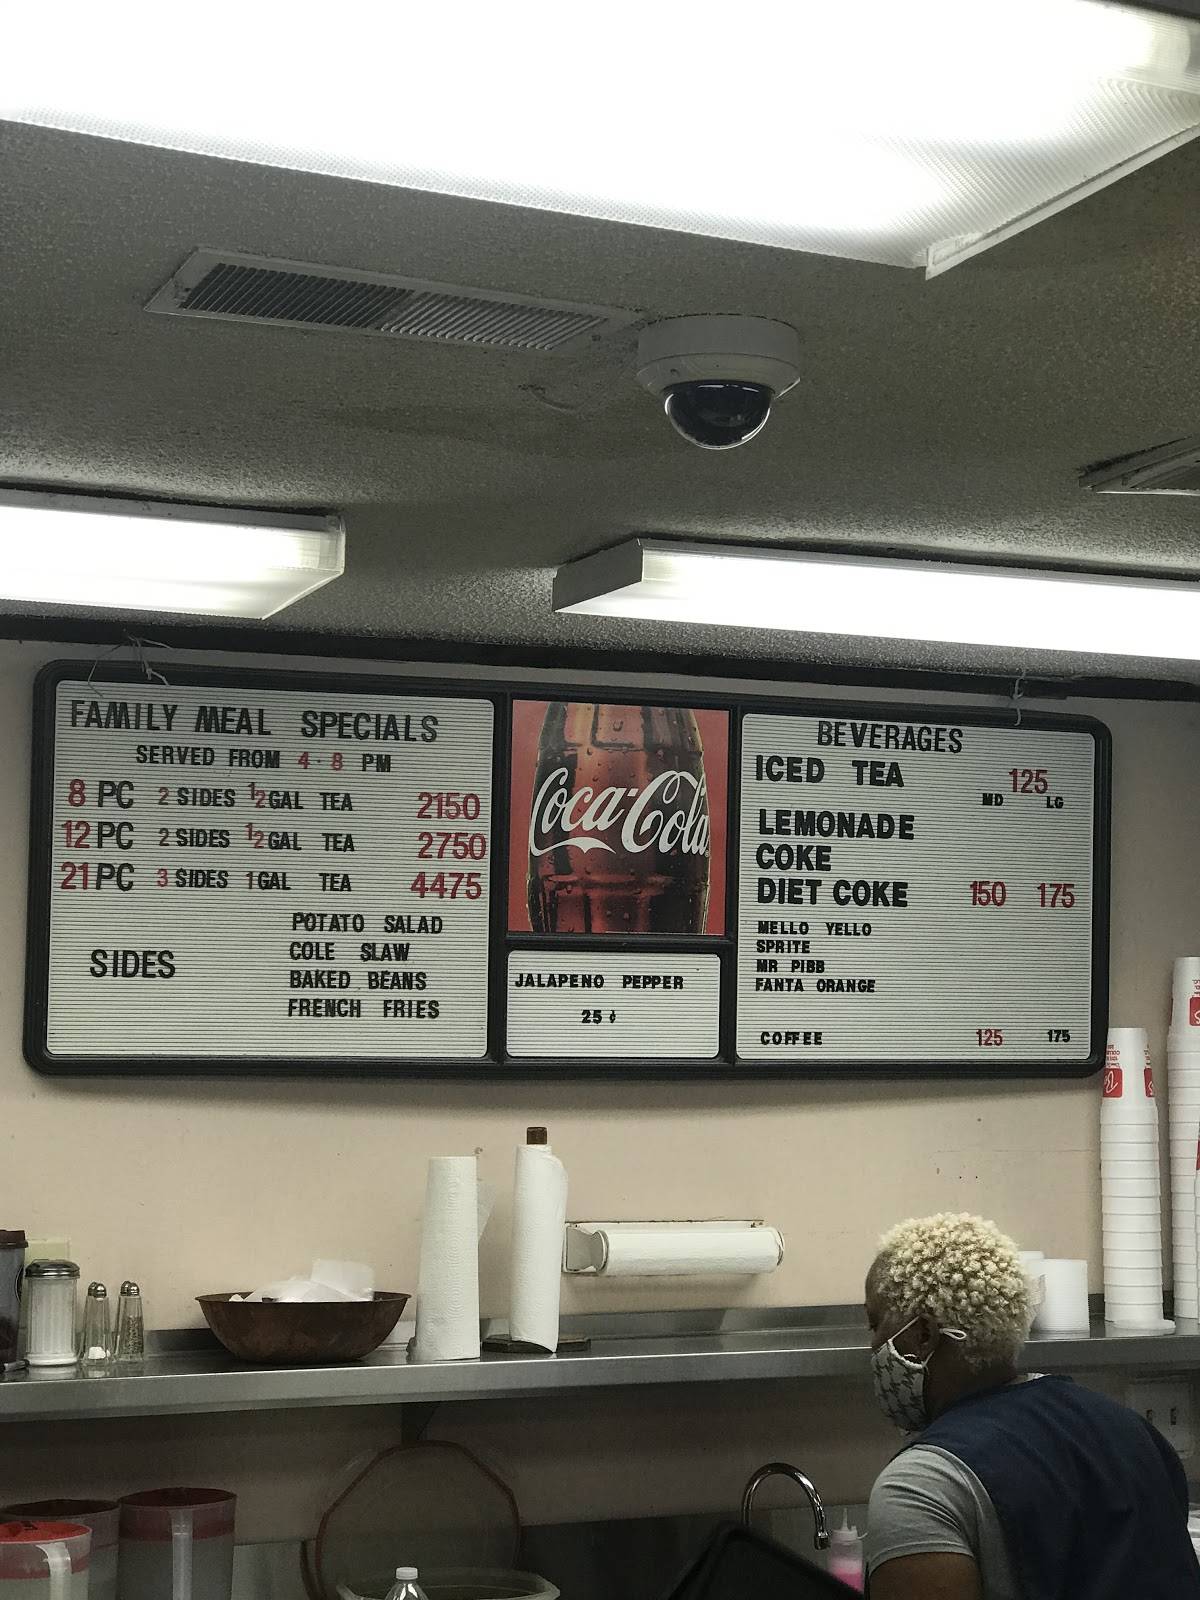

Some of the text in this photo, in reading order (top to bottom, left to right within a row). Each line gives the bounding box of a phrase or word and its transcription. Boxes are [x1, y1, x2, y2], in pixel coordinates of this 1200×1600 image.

[71, 700, 438, 742] FAMILY MEAL SPECIALS
[818, 720, 963, 753] BEVERAGES
[136, 745, 215, 765] SERVED
[229, 749, 280, 768] FROM
[298, 752, 310, 769] 4
[331, 753, 343, 770] 8
[362, 754, 392, 772] PM
[756, 755, 1048, 794] ICED TEA 125
[68, 779, 85, 807] 8
[98, 781, 134, 809] PC
[158, 787, 169, 805] 2
[177, 787, 236, 807] SIDES
[320, 792, 353, 811] TEA
[417, 792, 480, 820] 2150
[982, 793, 1064, 808] MD LG
[529, 767, 710, 857] Coca-Cola
[759, 809, 915, 840] LEMONADE
[62, 820, 90, 848] 12
[97, 821, 134, 850] PC
[158, 828, 169, 846] 2
[176, 828, 230, 848] SIDES
[322, 833, 354, 852] TEA
[417, 832, 486, 860] 2750
[756, 843, 831, 871] COKE
[96, 863, 134, 891] PC
[157, 869, 168, 887] 3
[176, 868, 229, 888] SIDES
[319, 873, 351, 891] TEA
[410, 872, 481, 899] 4475
[757, 878, 1075, 908] DIET COKE 150 175
[292, 912, 443, 934] POTATO SALAD
[757, 921, 872, 936] MELLO YELLO
[289, 941, 410, 962] COLE SLAW
[756, 940, 810, 953] SPRITE
[90, 949, 176, 978] SIDES
[756, 959, 825, 973] MR PIBB
[290, 970, 427, 990] BAKED BEANS
[515, 973, 684, 989] JALAPENO PEPPER
[755, 978, 876, 993] FANTA ORANGE
[288, 999, 440, 1019] FRENCH FRIES
[582, 1009, 602, 1024] 25
[761, 1028, 1071, 1046] COFFEE 125 175
